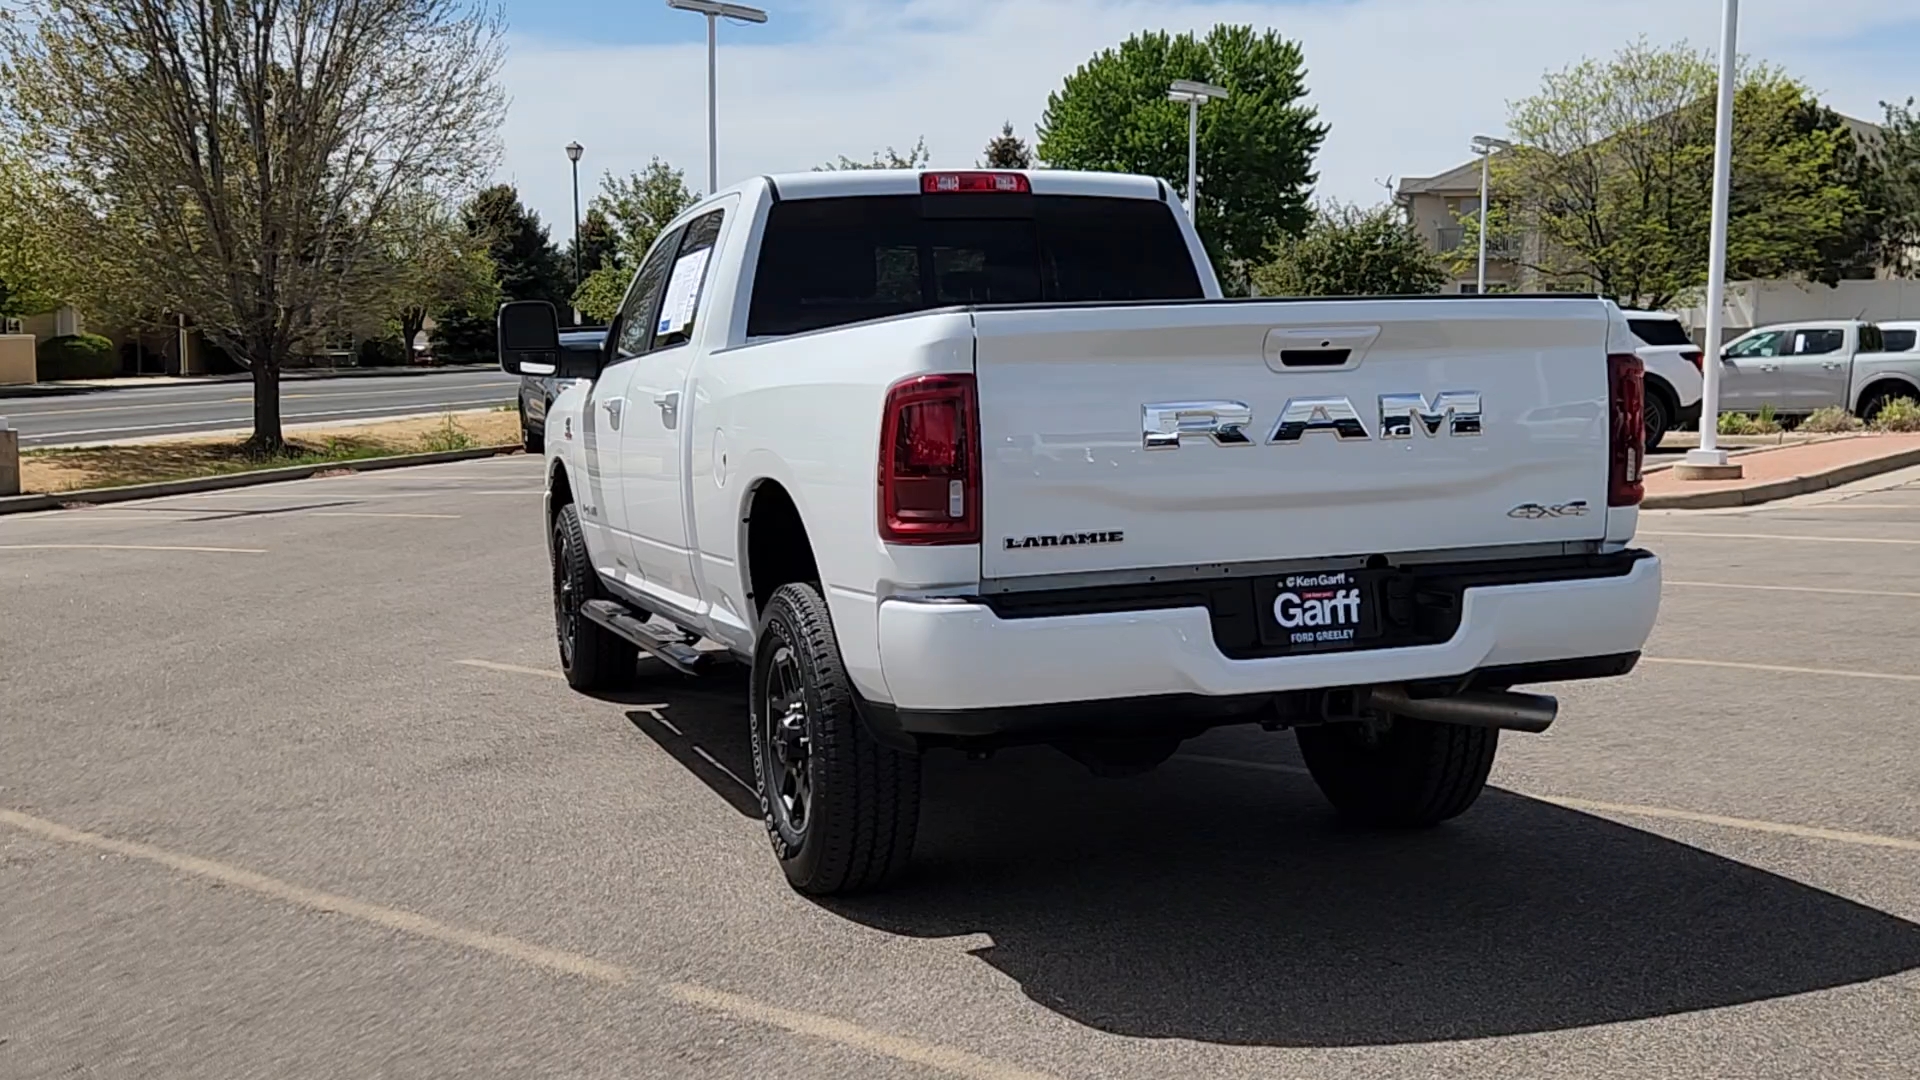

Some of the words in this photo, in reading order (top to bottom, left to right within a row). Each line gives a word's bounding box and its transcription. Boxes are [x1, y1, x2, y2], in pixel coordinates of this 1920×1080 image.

[1140, 390, 1483, 450] RAM
[1003, 530, 1124, 551] LARAMIE
[1296, 575, 1318, 587] Ken
[1318, 573, 1346, 586] Garff
[1274, 588, 1360, 628] Garff
[1290, 632, 1315, 643] FORD
[1316, 628, 1355, 642] GREELEY
